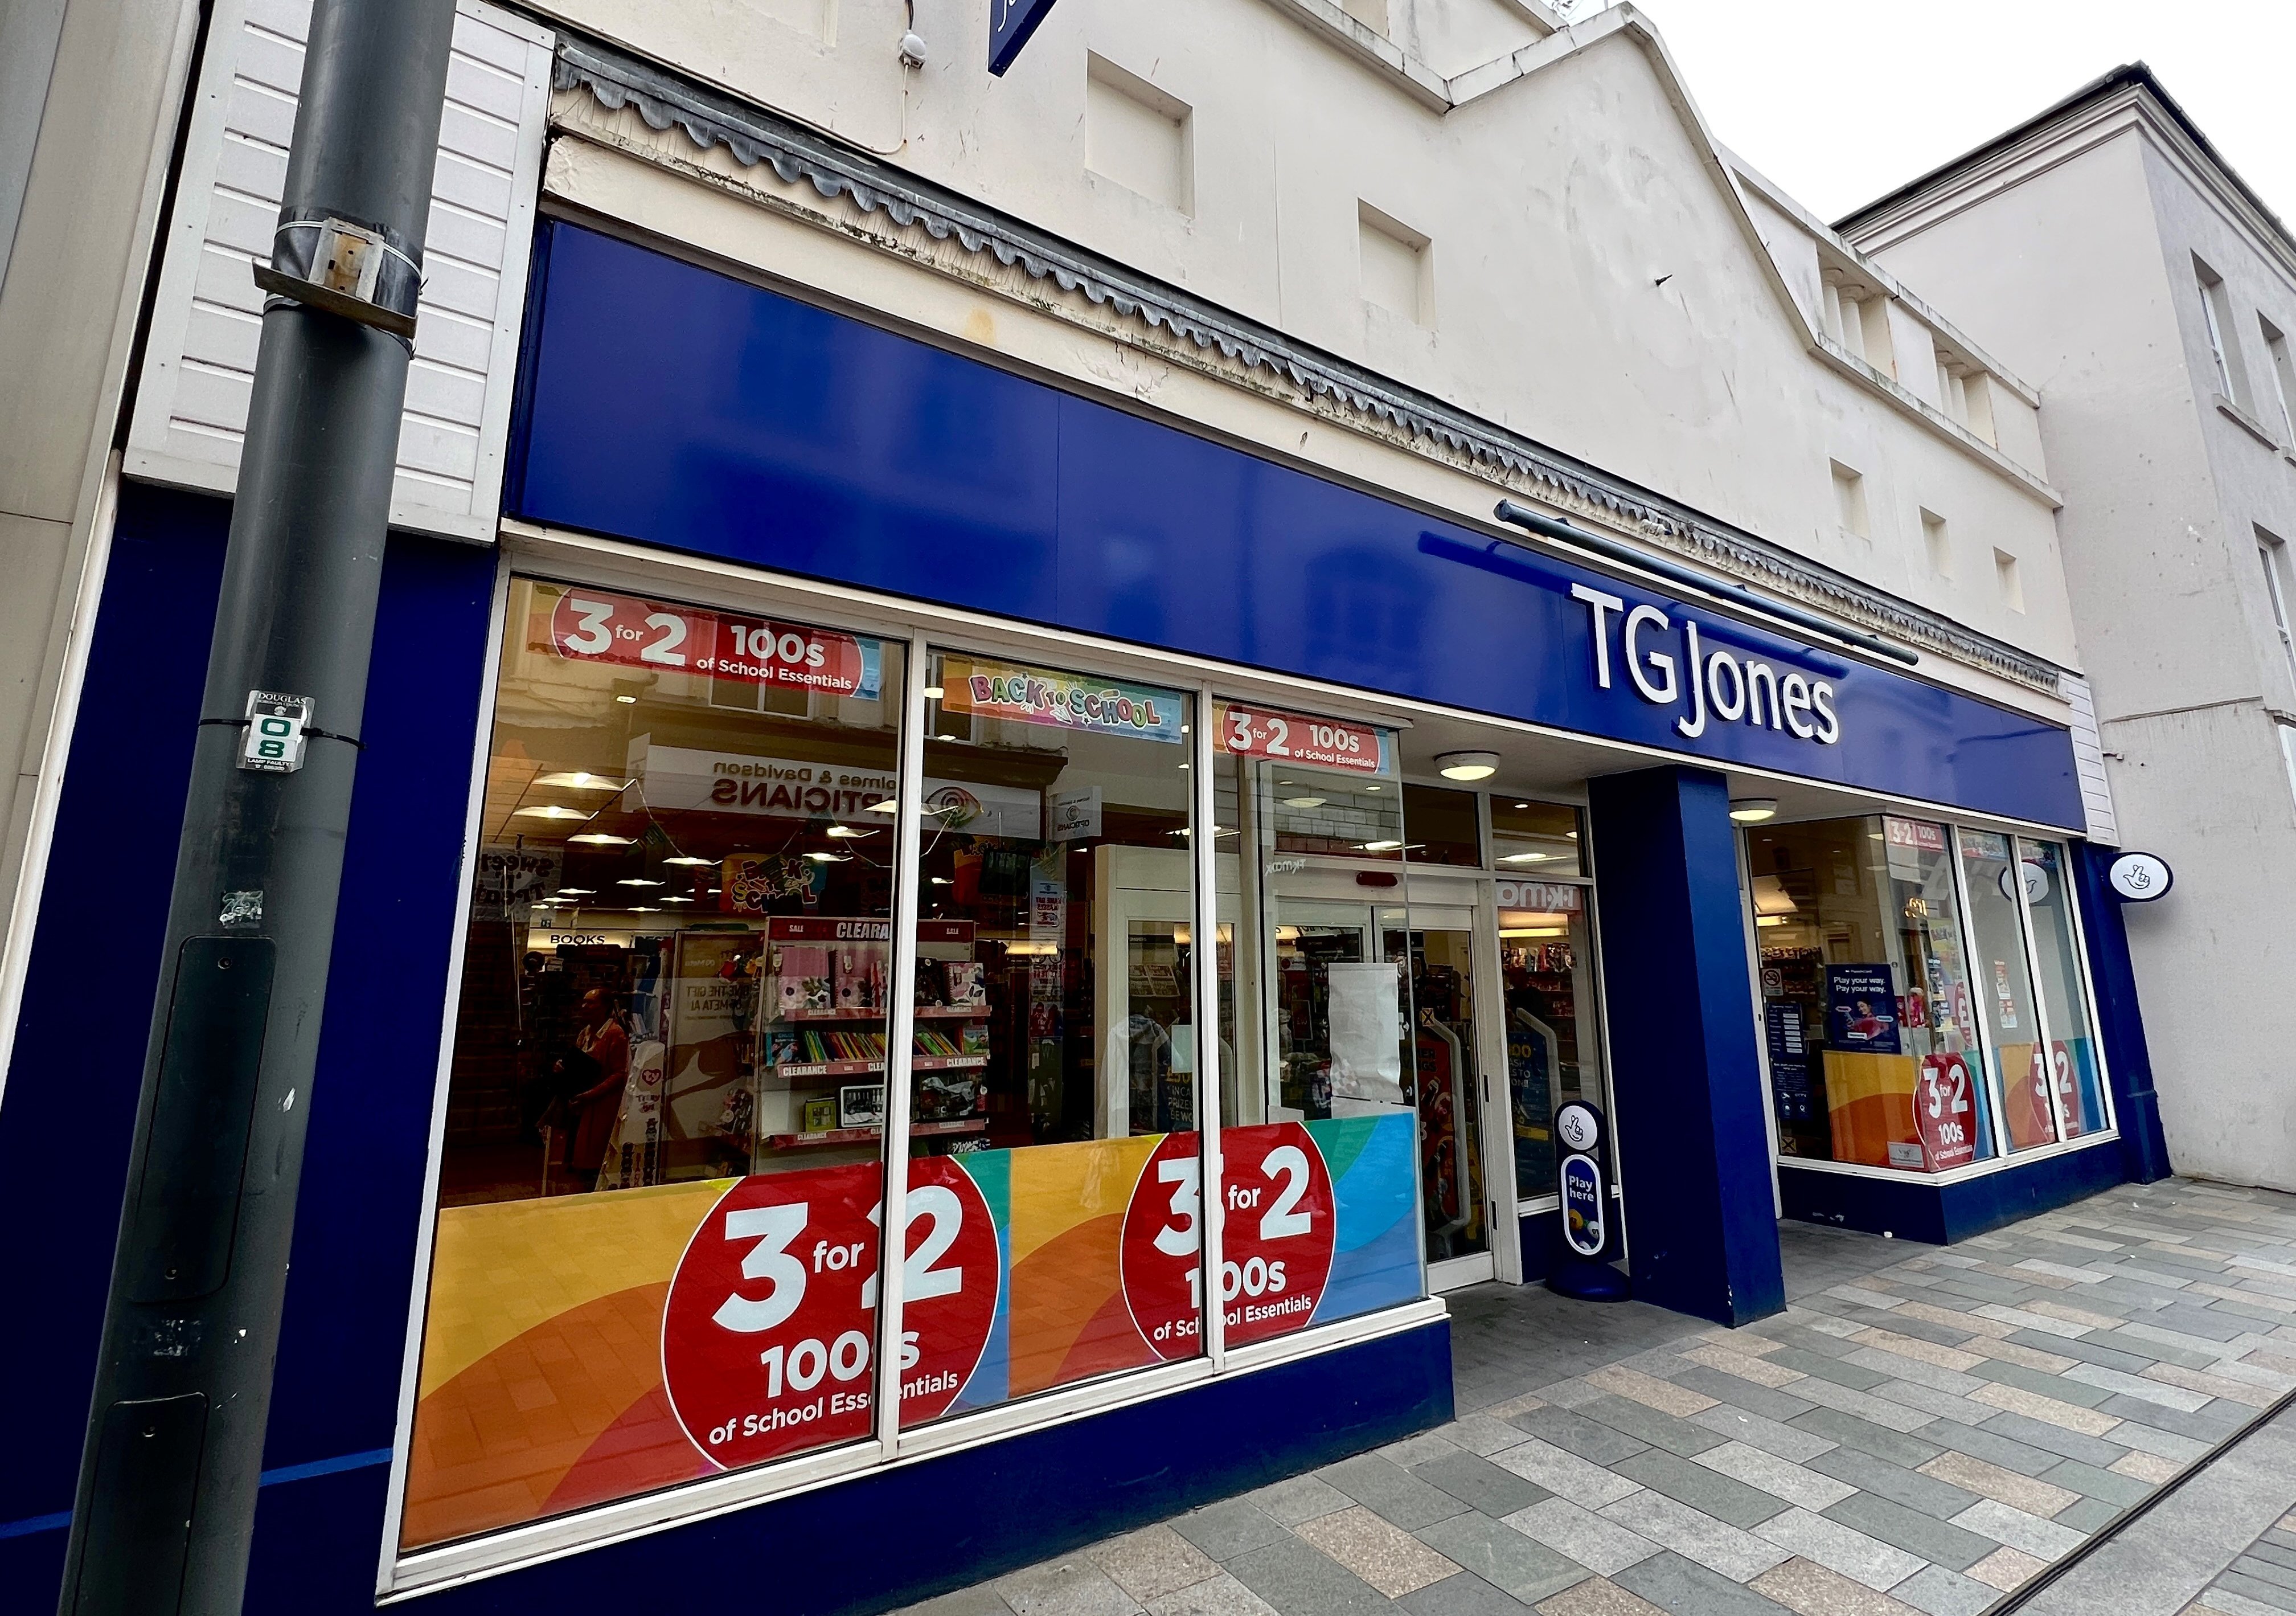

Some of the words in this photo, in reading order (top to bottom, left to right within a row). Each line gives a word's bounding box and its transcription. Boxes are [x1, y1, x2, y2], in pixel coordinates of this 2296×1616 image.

[563, 599, 614, 655] 3
[615, 625, 643, 641] for
[641, 613, 687, 667] 2
[731, 625, 825, 668] 100s
[696, 657, 715, 670] of
[719, 659, 773, 679] School
[778, 669, 852, 690] Essentials
[259, 692, 306, 705] DOUGLAS
[970, 675, 1045, 709] BACK
[1069, 688, 1161, 728] SCHOOL
[1228, 711, 1252, 750] 3
[1253, 728, 1267, 740] for
[1266, 718, 1289, 756] 2
[1310, 725, 1360, 752] 100s
[1294, 748, 1304, 758] of
[1306, 750, 1334, 763] School
[1336, 754, 1375, 768] Essentials
[1904, 823, 1913, 845] 2
[550, 935, 605, 945] BOOKS
[836, 922, 890, 939] CLEARA
[1834, 976, 1850, 985] Play
[1836, 985, 1850, 993] Pay
[783, 1065, 827, 1077] CLEARANCE
[946, 1057, 985, 1067] CLEARANCE
[2056, 1051, 2072, 1094] 2
[1922, 1067, 1942, 1119] 3
[1949, 1063, 1968, 1114] 2
[1938, 1122, 1964, 1145] 100s
[1228, 1184, 1261, 1211] for
[1260, 1145, 1311, 1241] 2
[1569, 1175, 1593, 1192] Play
[1569, 1187, 1594, 1202] here
[712, 1202, 809, 1333] 3
[813, 1240, 864, 1273] for
[861, 1185, 963, 1310] 2
[1154, 1321, 1171, 1341] of
[1245, 1294, 1312, 1323] Essentials
[708, 1418, 737, 1445] of
[743, 1397, 823, 1437] School
